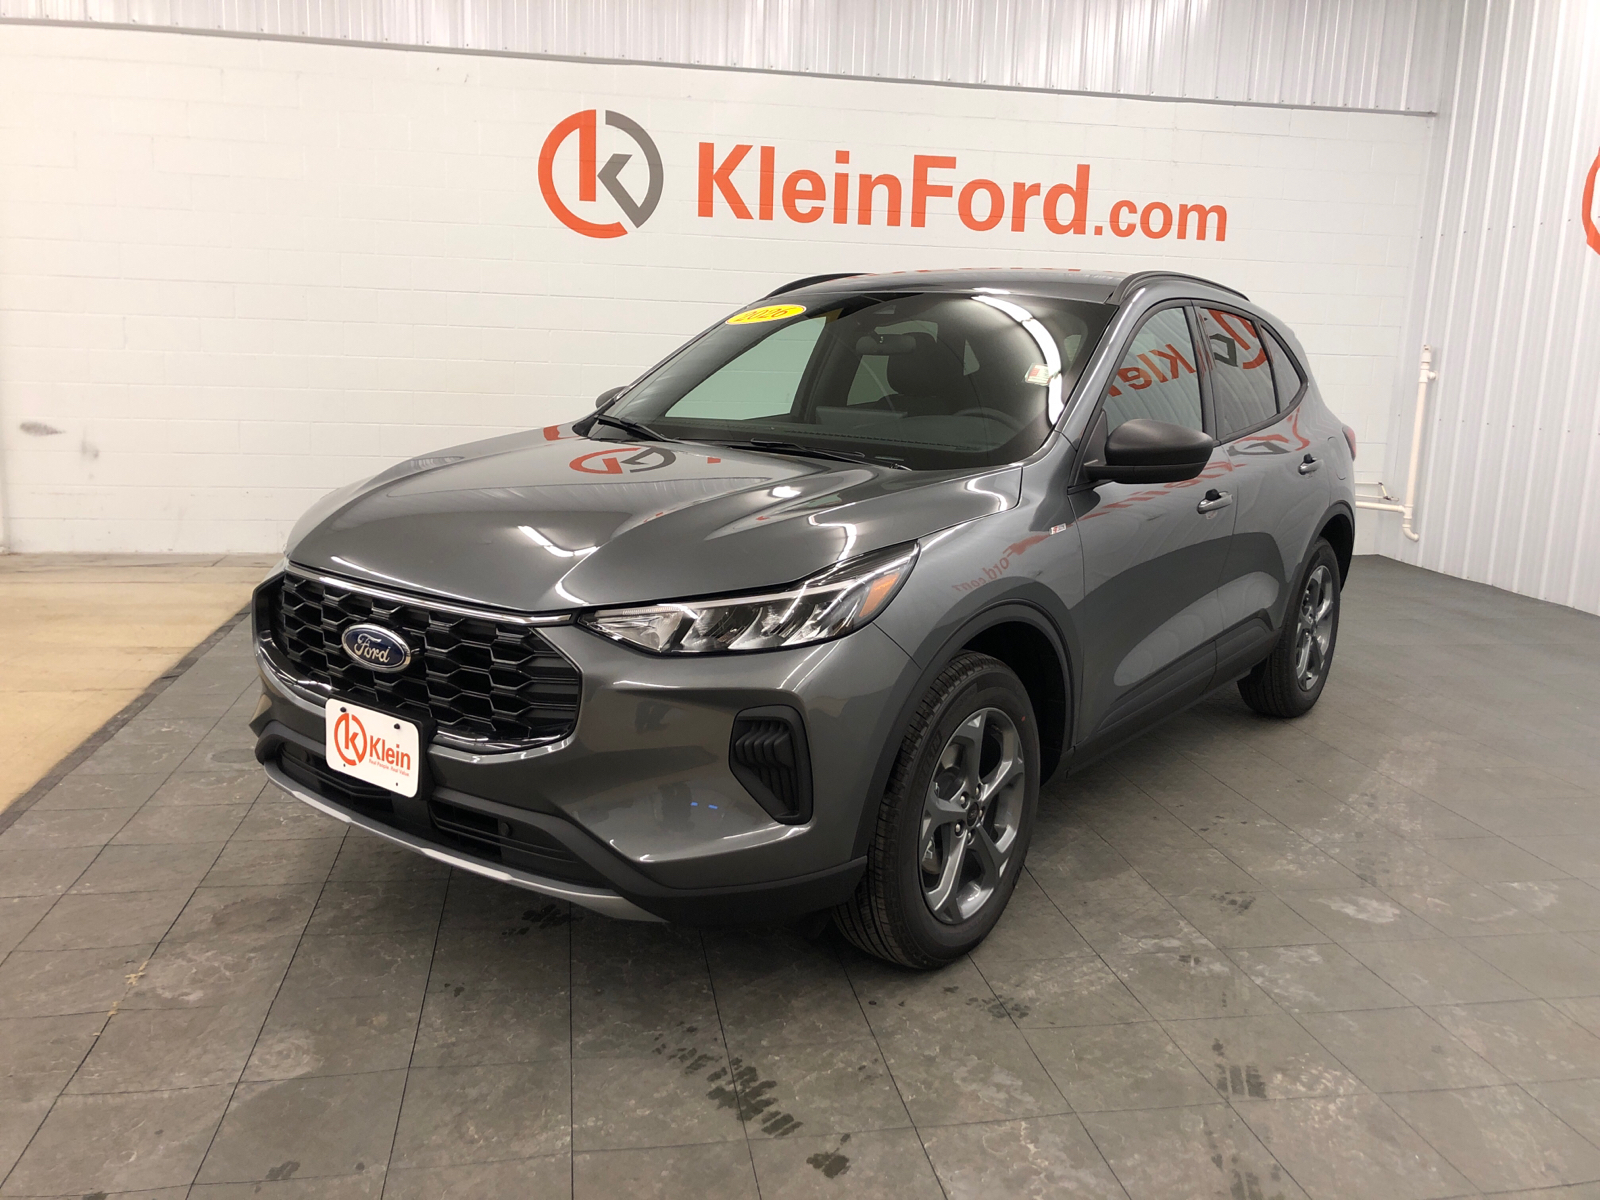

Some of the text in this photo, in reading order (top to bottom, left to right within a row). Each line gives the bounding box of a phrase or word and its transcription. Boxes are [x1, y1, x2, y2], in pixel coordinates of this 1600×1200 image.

[697, 141, 1228, 242] KleinFord.com
[354, 633, 391, 663] Ford
[369, 735, 411, 771] Klein
